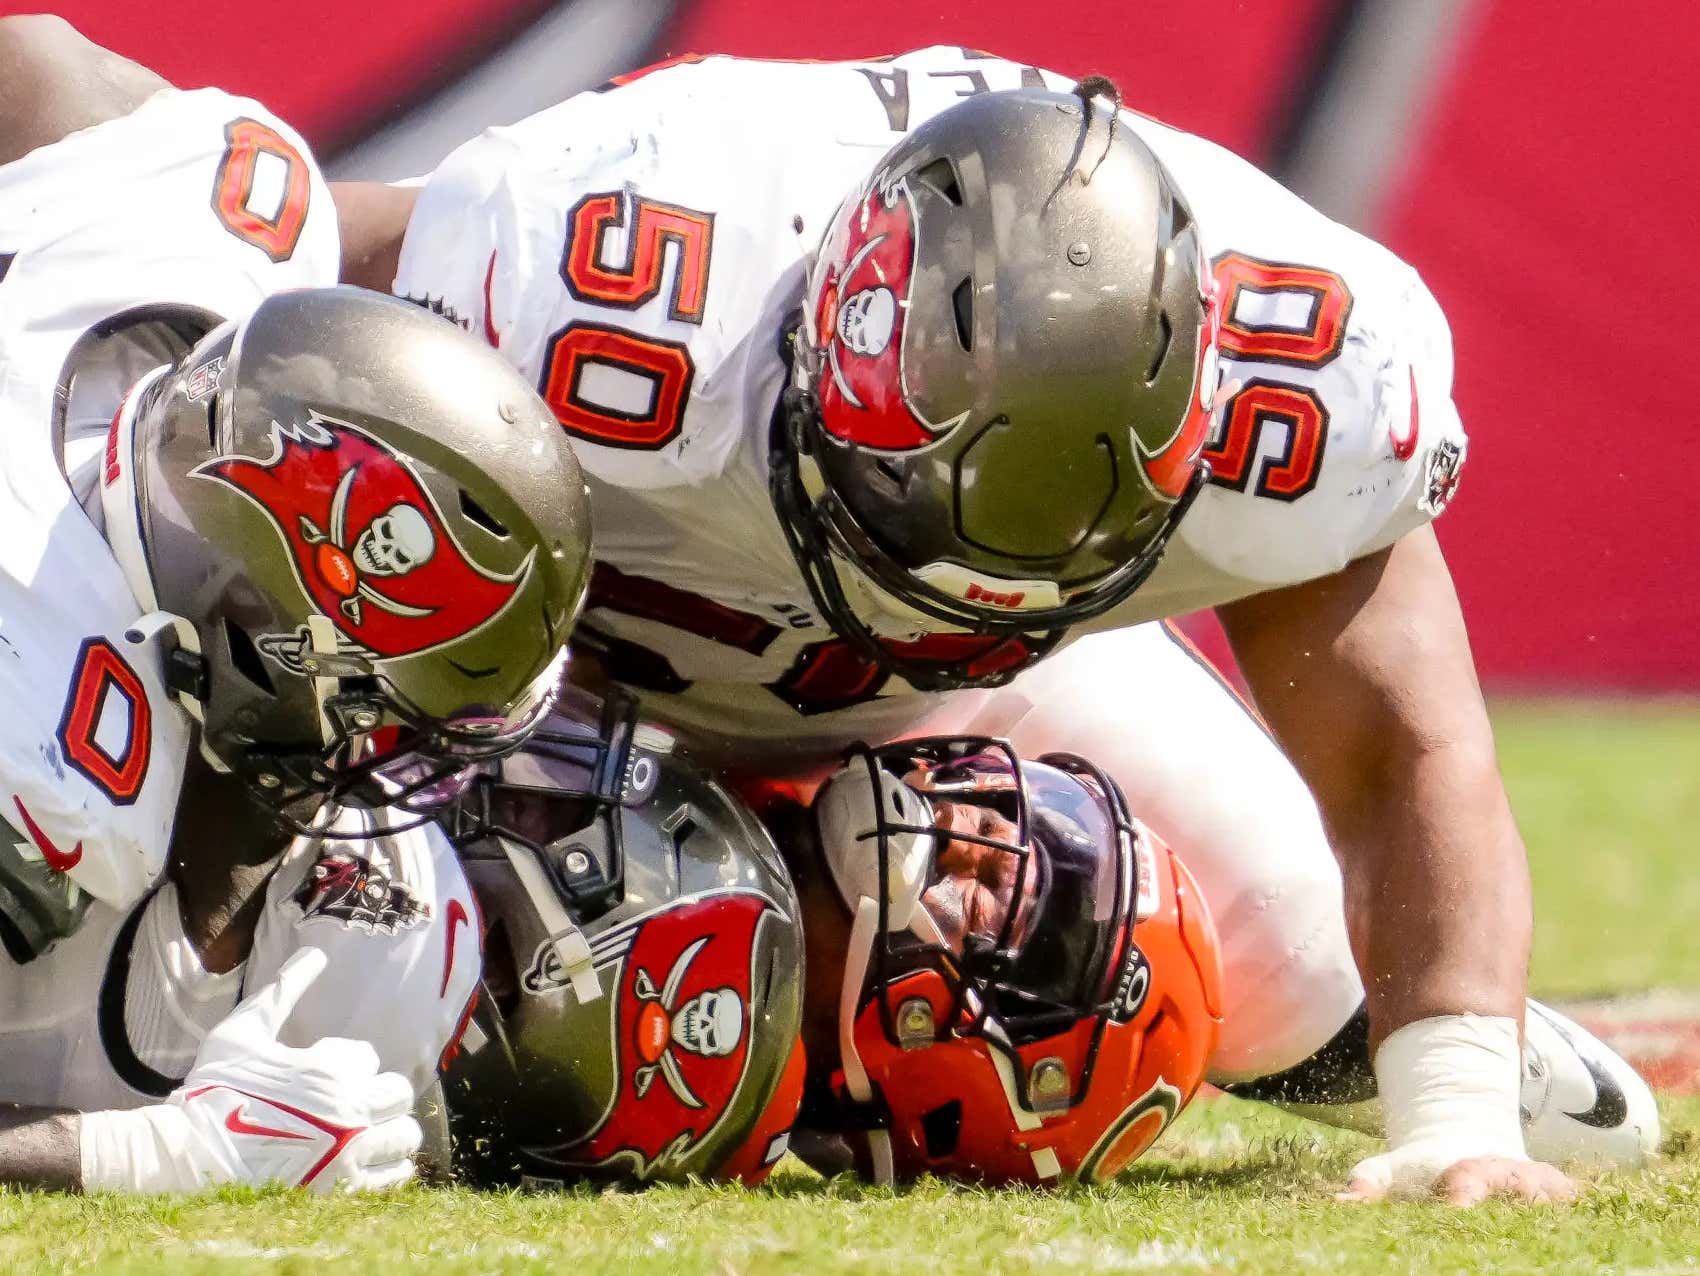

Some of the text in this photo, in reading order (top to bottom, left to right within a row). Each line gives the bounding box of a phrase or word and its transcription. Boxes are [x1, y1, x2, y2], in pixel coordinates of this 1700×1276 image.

[539, 188, 717, 451] 50
[1202, 249, 1354, 502] 50
[56, 635, 152, 806] 0
